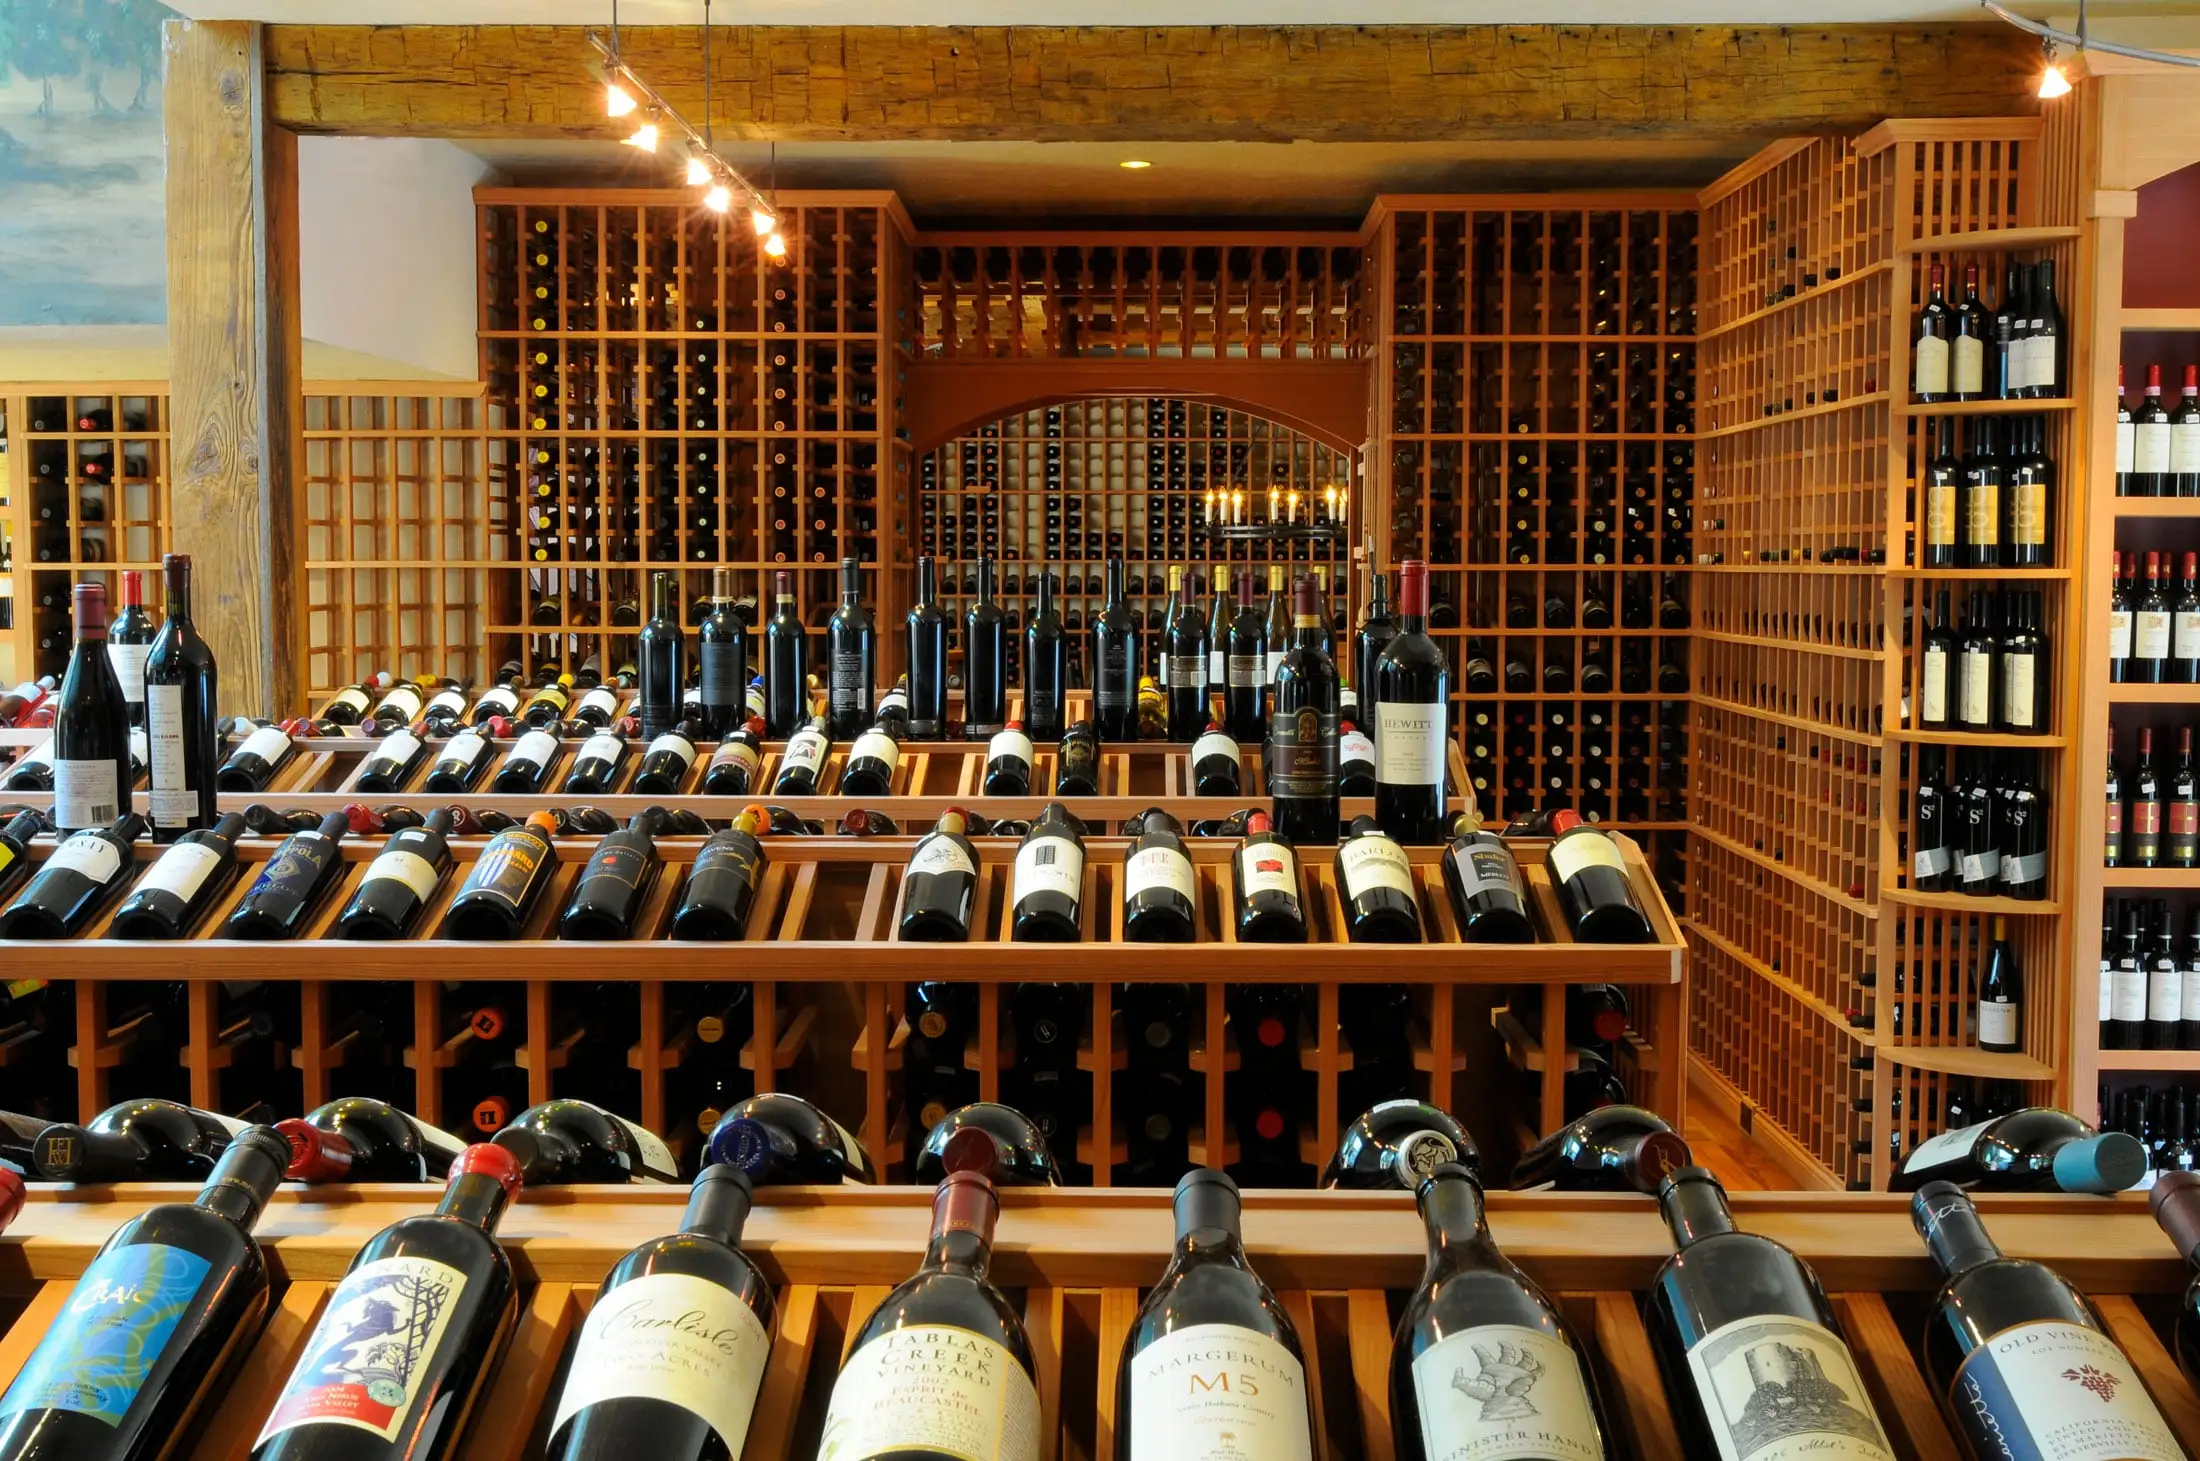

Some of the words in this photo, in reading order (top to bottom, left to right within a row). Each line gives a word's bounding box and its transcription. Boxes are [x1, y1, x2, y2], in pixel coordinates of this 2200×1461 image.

[1384, 718, 1432, 729] HEWITT
[600, 1299, 739, 1356] Carlisle
[886, 1332, 995, 1359] TABLAS
[1999, 1331, 2040, 1354] OLD
[2049, 1331, 2094, 1344] VINE
[651, 1350, 712, 1377] ACRES
[684, 1345, 722, 1368] VALLEY
[880, 1349, 991, 1375] CREEK
[1149, 1350, 1294, 1388] MARGERUM
[876, 1363, 991, 1387] VINEYARD
[1188, 1371, 1260, 1397] M5
[1538, 1432, 1593, 1456] HAND
